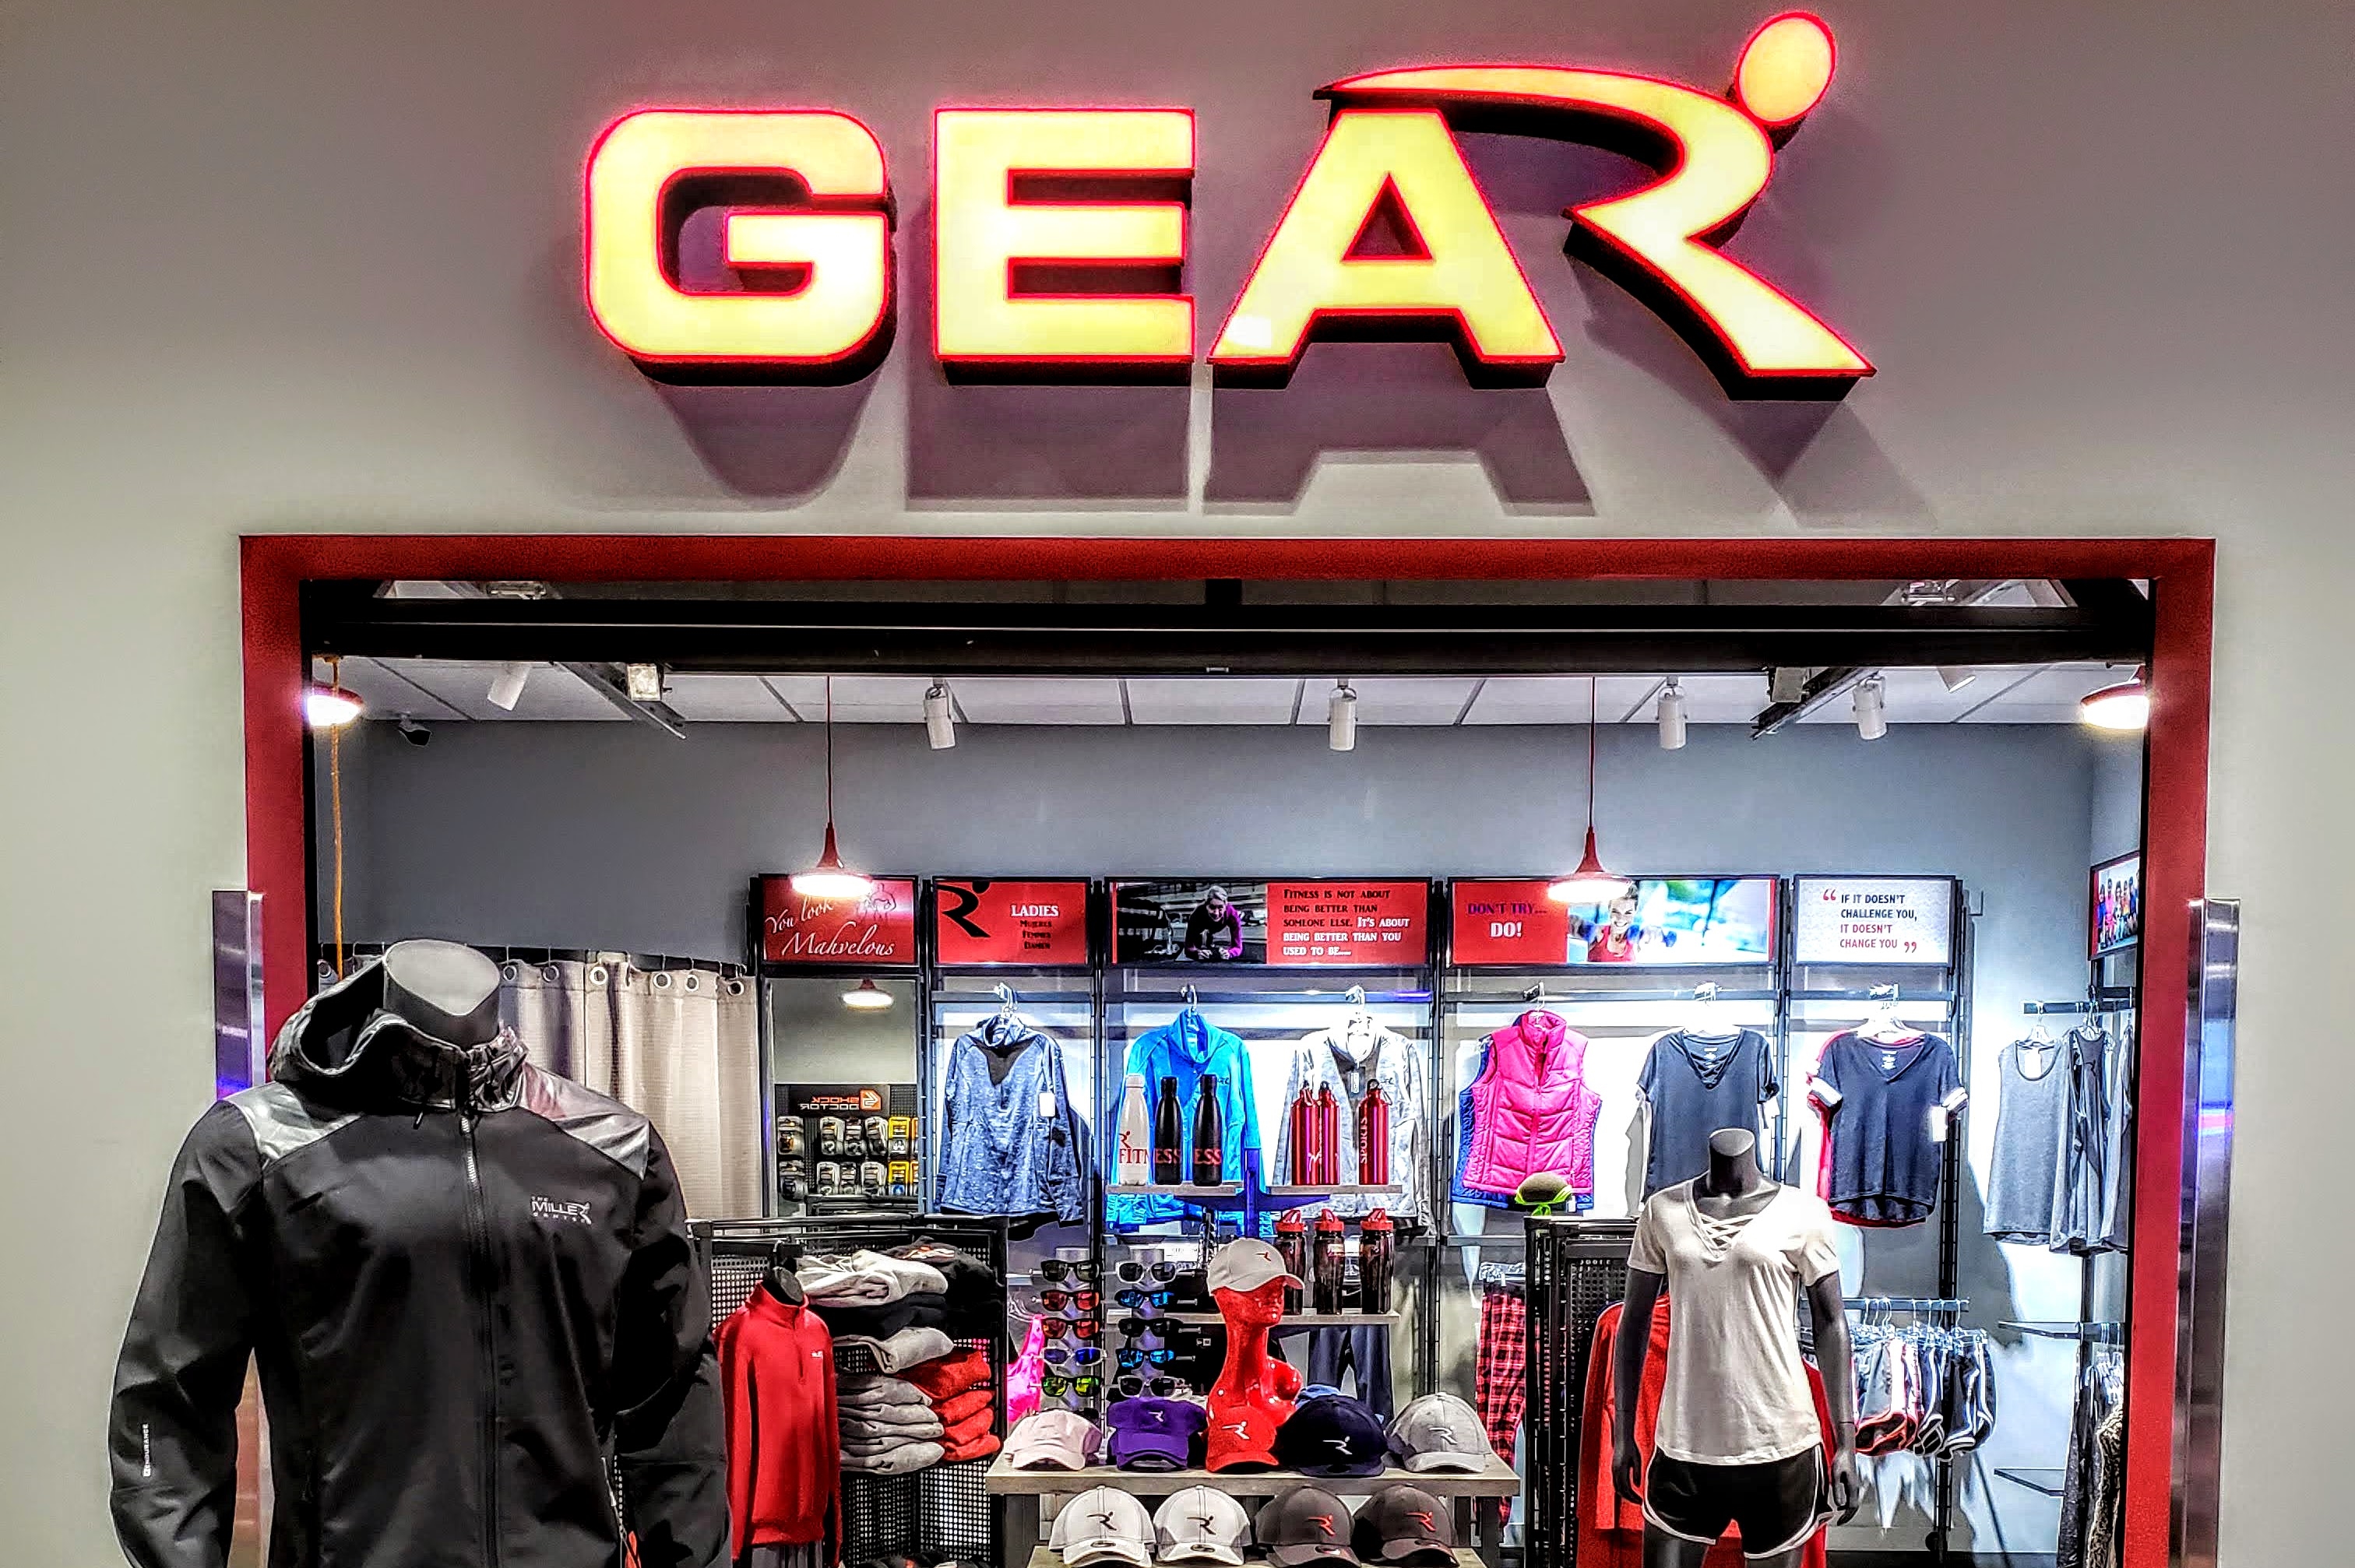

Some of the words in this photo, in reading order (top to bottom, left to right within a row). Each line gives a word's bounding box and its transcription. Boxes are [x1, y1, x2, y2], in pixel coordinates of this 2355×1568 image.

[586, 11, 1877, 380] GEAR
[1283, 889, 1319, 898] FITNESS
[1324, 890, 1332, 898] IS
[1337, 890, 1355, 898] NOT
[1361, 890, 1390, 898] ABOUT
[1841, 895, 1850, 904] IF
[1853, 895, 1862, 904] IT
[1864, 895, 1906, 904] DOESN'T
[1011, 905, 1060, 917] LADIES
[1283, 905, 1310, 913] BEING
[1315, 905, 1348, 913] BETTER
[1354, 905, 1378, 913] THAN
[1468, 902, 1507, 914] DON'T
[1840, 909, 1893, 919] CHALLENGE
[1896, 909, 1917, 922] YOU,
[765, 909, 794, 933] You
[1283, 919, 1325, 927] SOMEONE
[1357, 916, 1375, 928] IT'S
[1378, 918, 1410, 927] ABOUT
[1490, 921, 1522, 937] DO!
[1840, 924, 1849, 933] IT
[1853, 924, 1892, 933] DOESN'T
[1283, 932, 1310, 941] BEING
[1314, 932, 1348, 941] BETTER
[1352, 932, 1378, 941] THAN
[1382, 932, 1402, 941] YOU
[1839, 939, 1877, 948] CHANGE
[1879, 939, 1898, 948] YOU
[1283, 947, 1307, 956] USED
[1310, 947, 1324, 956] TO
